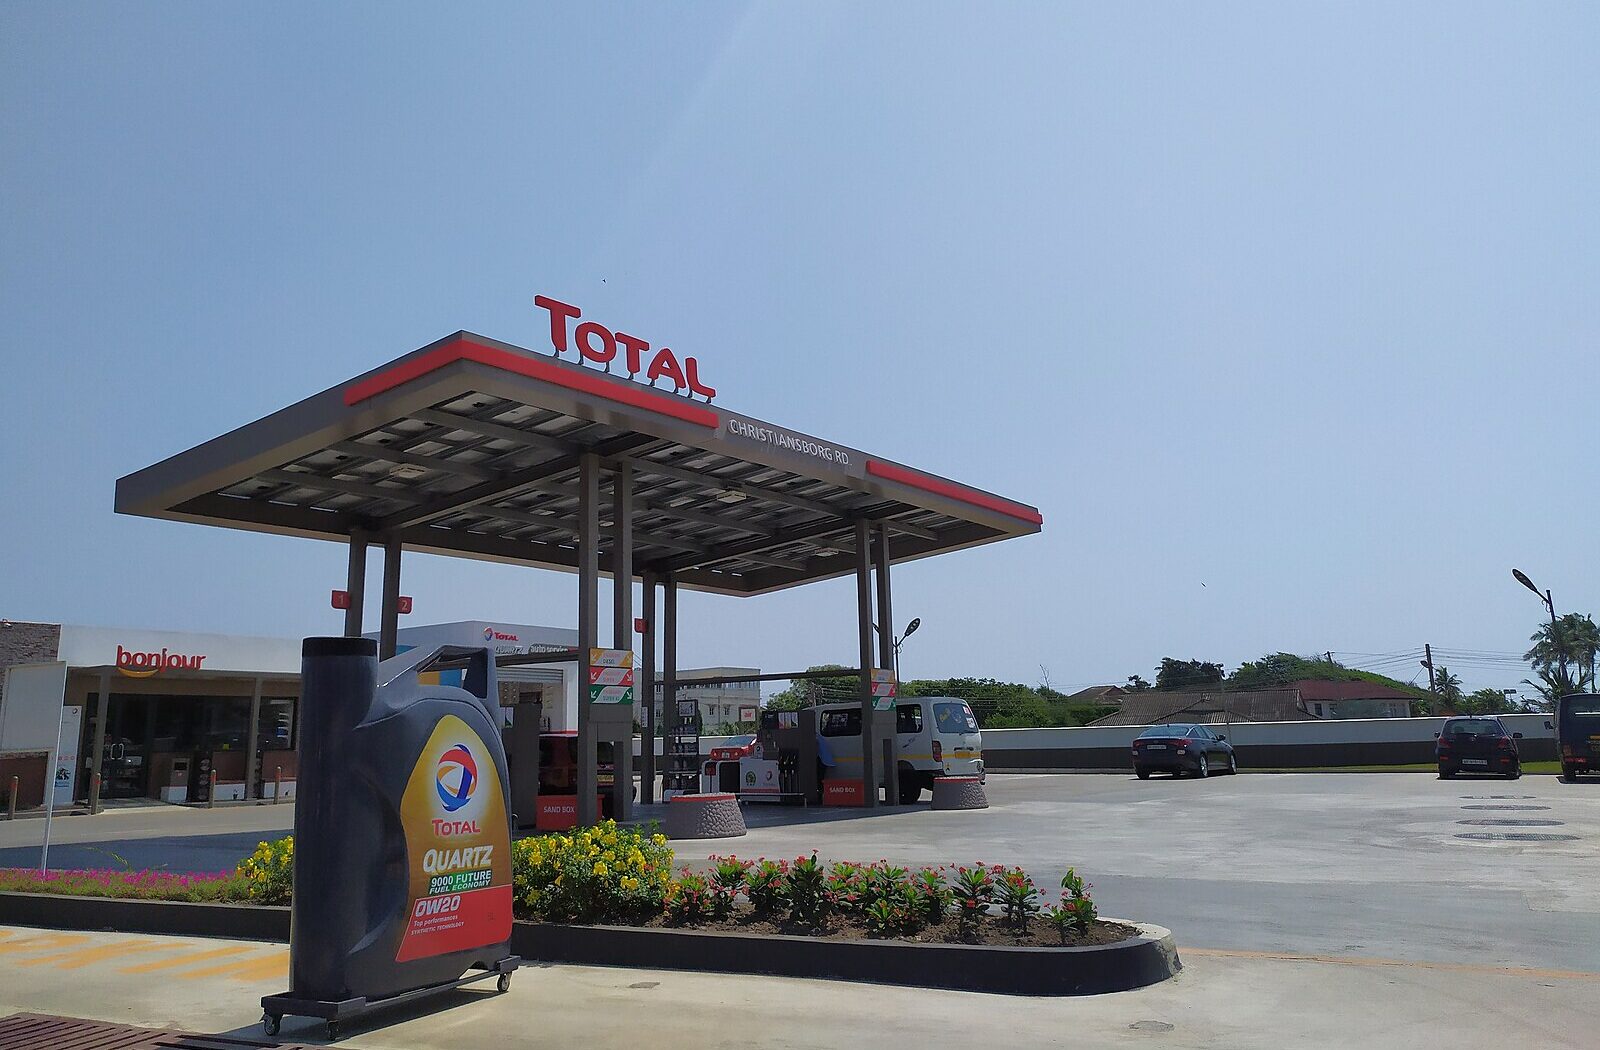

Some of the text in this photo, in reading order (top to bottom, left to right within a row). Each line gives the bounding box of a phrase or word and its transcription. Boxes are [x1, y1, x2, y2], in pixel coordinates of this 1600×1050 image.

[534, 295, 716, 399] TOTAL
[729, 419, 833, 461] CHRISTIANSBORG
[402, 600, 408, 611] 2
[494, 632, 519, 642] TOTAL
[115, 645, 206, 673] bonjour
[543, 806, 575, 814] SAND BOX
[432, 819, 480, 836] TOTAL
[423, 845, 493, 874] QUARTZ
[429, 879, 491, 895] FUEL ECONOMY
[431, 870, 492, 888] 9000 FUTURE
